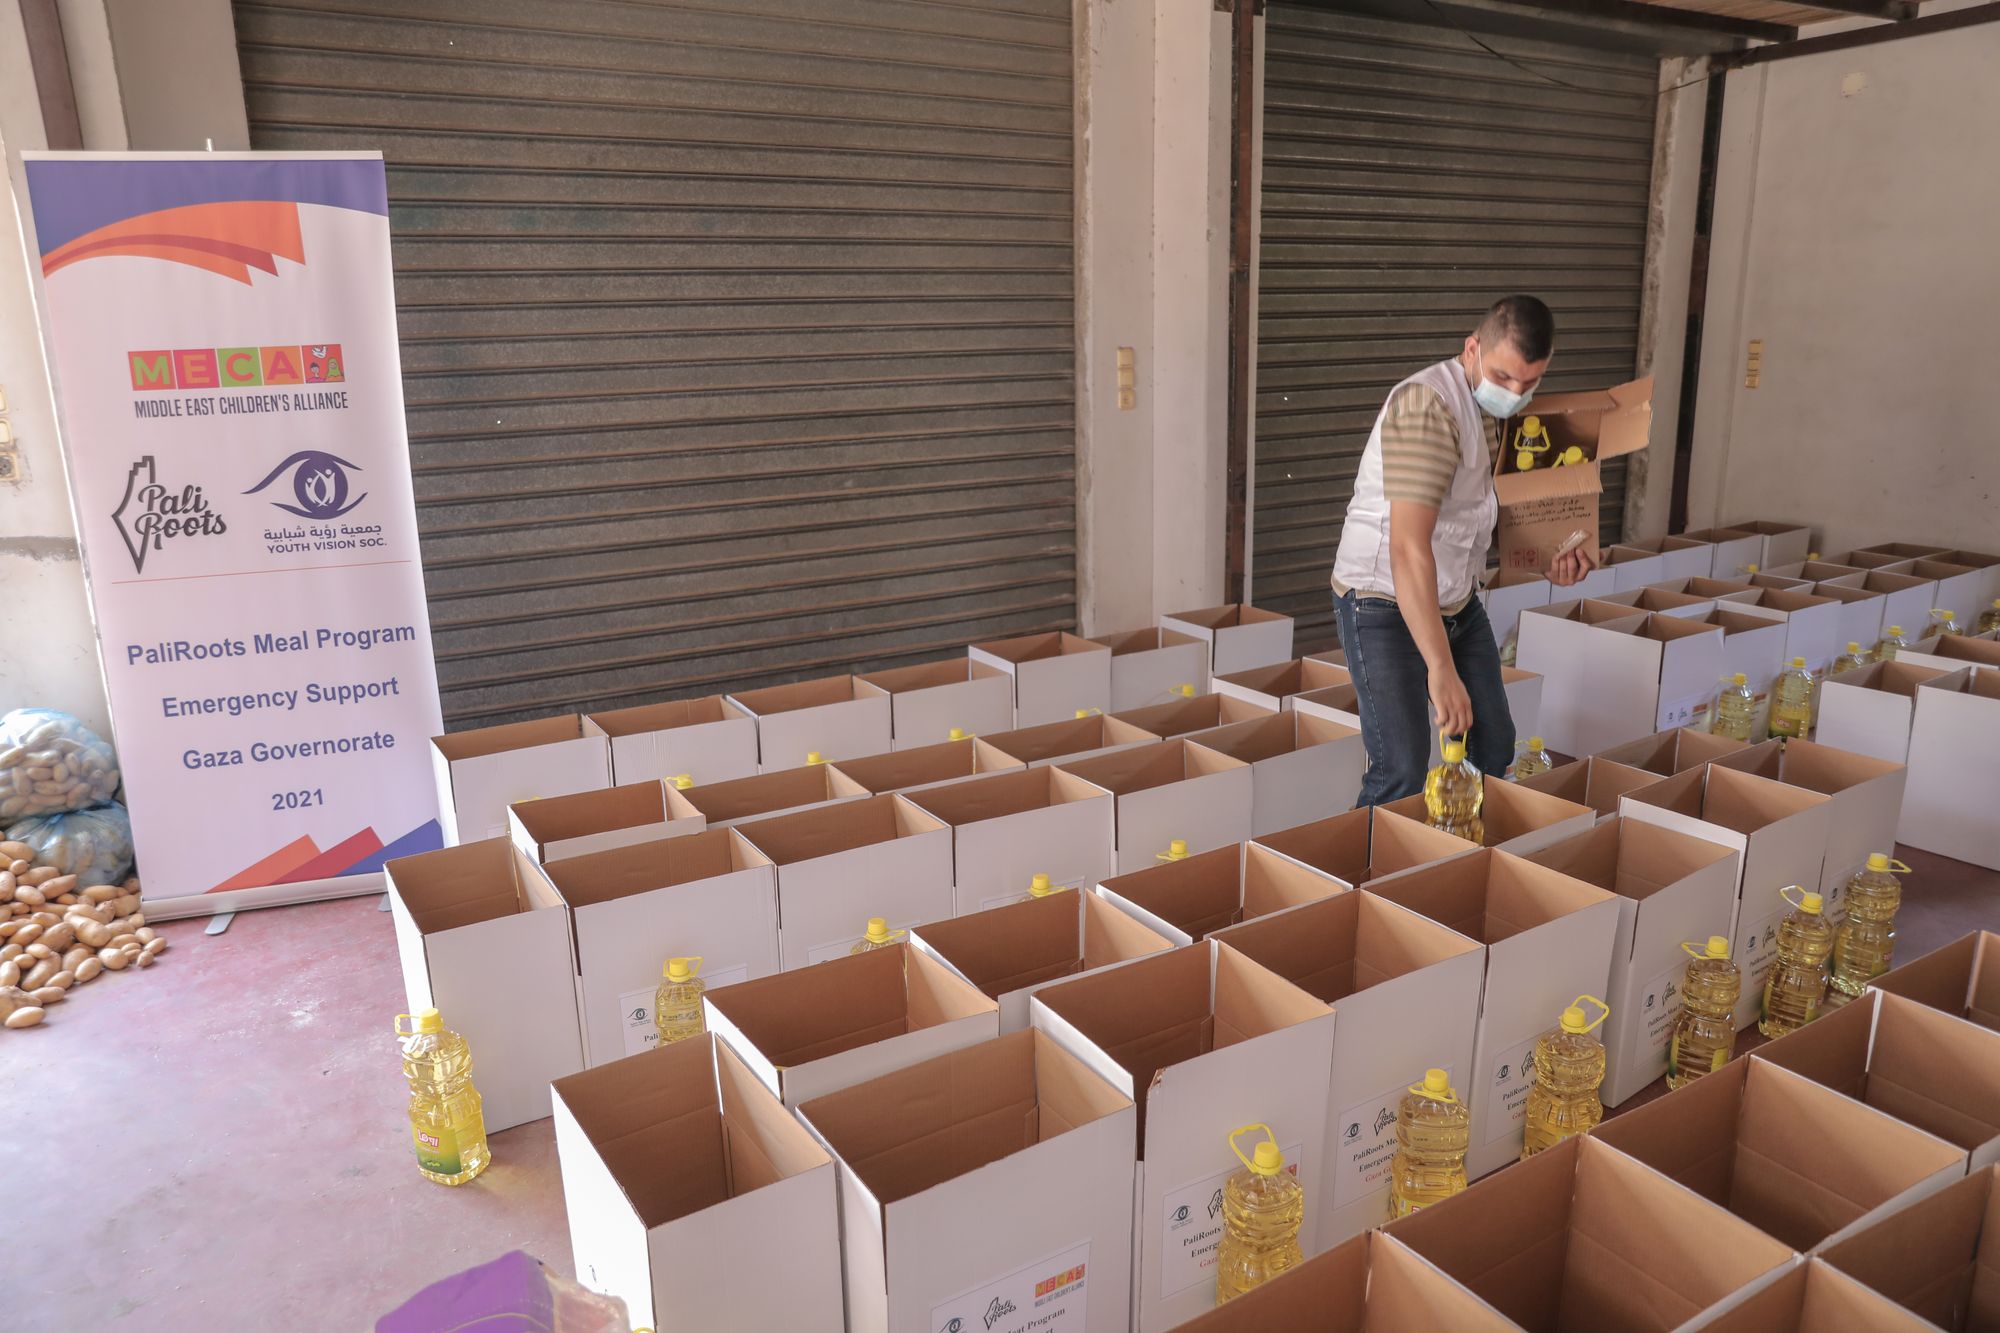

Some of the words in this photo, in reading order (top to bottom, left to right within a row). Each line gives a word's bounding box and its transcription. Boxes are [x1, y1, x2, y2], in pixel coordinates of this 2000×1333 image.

[131, 350, 299, 386] MECA
[134, 398, 182, 418] MIDDLE
[186, 397, 215, 416] EAST
[219, 393, 290, 415] CHILDREN'S
[293, 391, 349, 411] ALLIANCE
[137, 483, 209, 516] Pali
[134, 510, 227, 551] Roots
[263, 526, 306, 543] شبابية
[309, 524, 337, 541] رؤية
[340, 523, 382, 538] جمعية
[267, 542, 310, 554] YOUTH
[313, 539, 356, 551] VISION
[359, 537, 388, 548] SOC.
[127, 638, 247, 666] PaliRoots
[253, 630, 309, 655] Meal
[315, 625, 417, 651] Program
[162, 689, 298, 718] Emergency
[305, 676, 400, 705] Support
[182, 748, 244, 770] Gaza
[250, 731, 396, 763] Governorate
[271, 788, 324, 811] 2021
[1183, 1226, 1221, 1247] PaliRoots
[1027, 1307, 1066, 1331] Program
